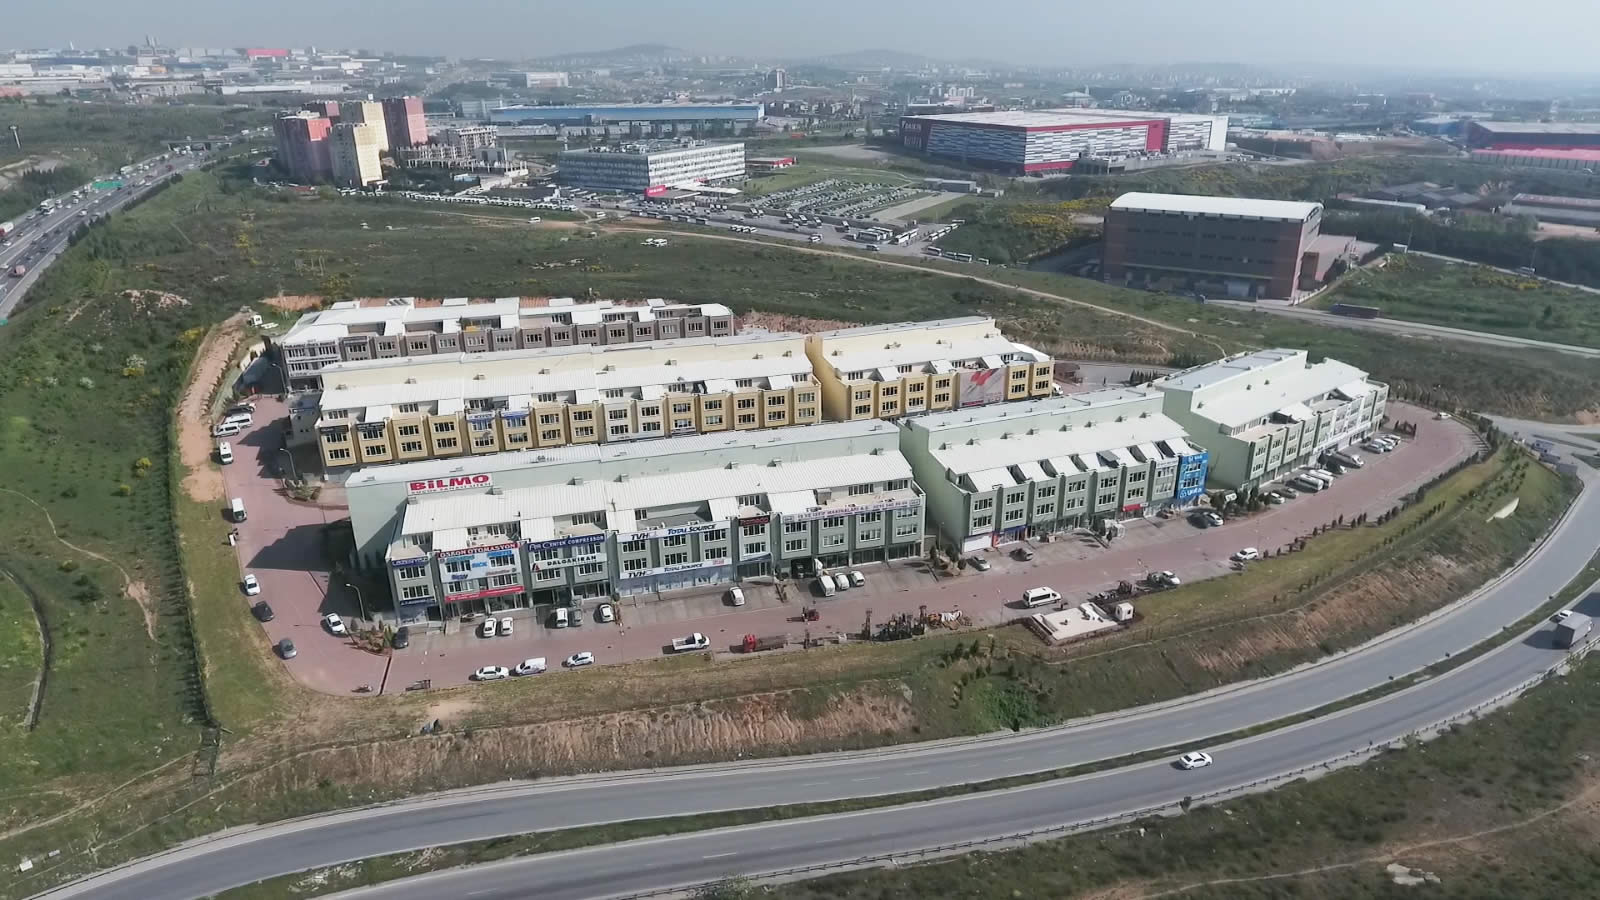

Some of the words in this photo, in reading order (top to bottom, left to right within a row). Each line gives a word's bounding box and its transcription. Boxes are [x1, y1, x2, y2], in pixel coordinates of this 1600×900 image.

[631, 532, 649, 541] TVH
[667, 527, 688, 536] TOTAL
[689, 523, 717, 533] SOURCE
[467, 543, 516, 555] OTOMASYON
[547, 555, 597, 567] DALGAKIRAN
[628, 570, 646, 578] TVH
